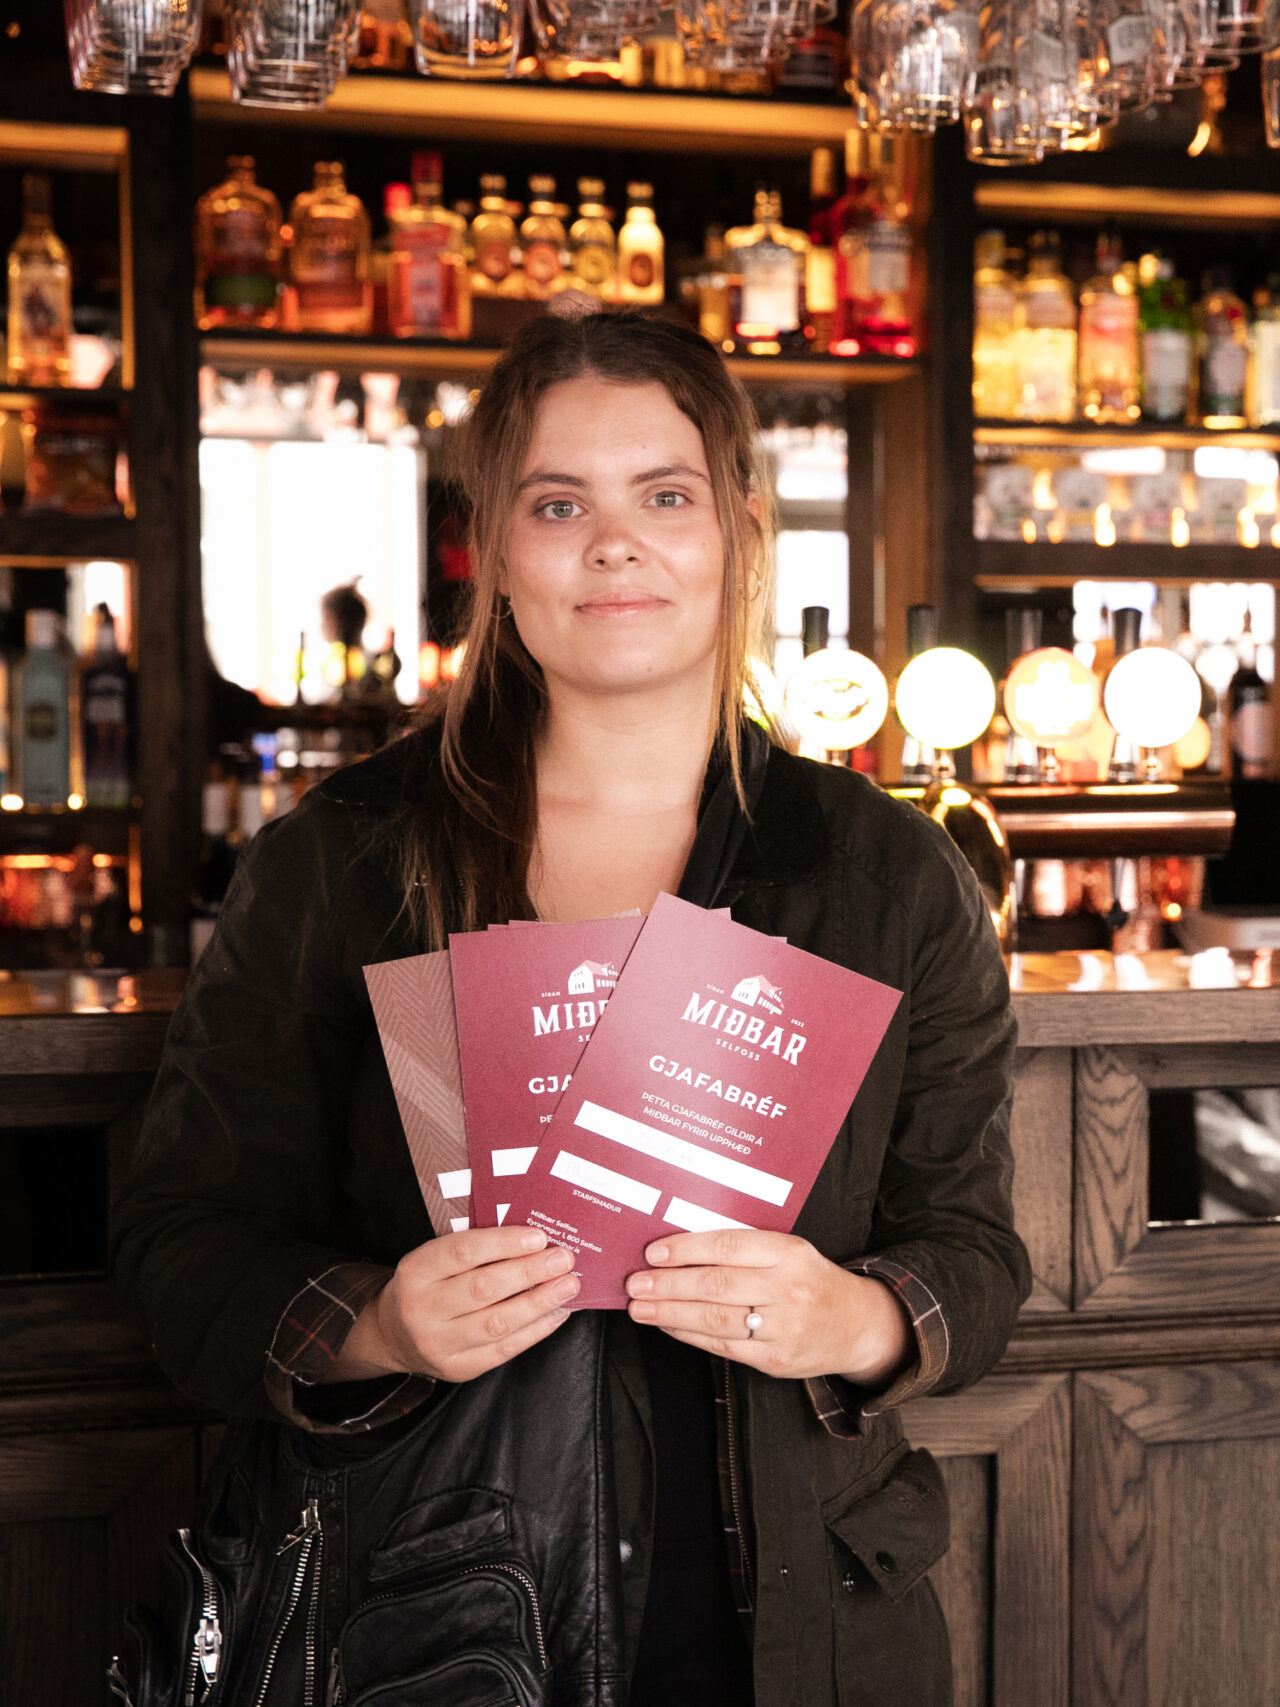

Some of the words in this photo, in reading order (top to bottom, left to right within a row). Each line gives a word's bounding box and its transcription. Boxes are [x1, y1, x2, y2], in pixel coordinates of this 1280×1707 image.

[680, 992, 807, 1066] MIÐBAR
[714, 1038, 761, 1062] SELFOSS
[649, 1055, 787, 1119] GJAFABRÉF
[641, 1092, 670, 1110] ÞETTA
[671, 1104, 725, 1131] GJAFABRÉF
[724, 1125, 755, 1143] GILDIR
[755, 1137, 764, 1147] Á
[643, 1106, 681, 1128] MIÐBAR
[681, 1122, 709, 1139] FYRIR
[709, 1133, 751, 1155] UPPHÆÐ
[572, 1189, 622, 1214] STARFSMAÐUR
[556, 1220, 578, 1234] Selfoss
[580, 1239, 602, 1253] Selfoss
